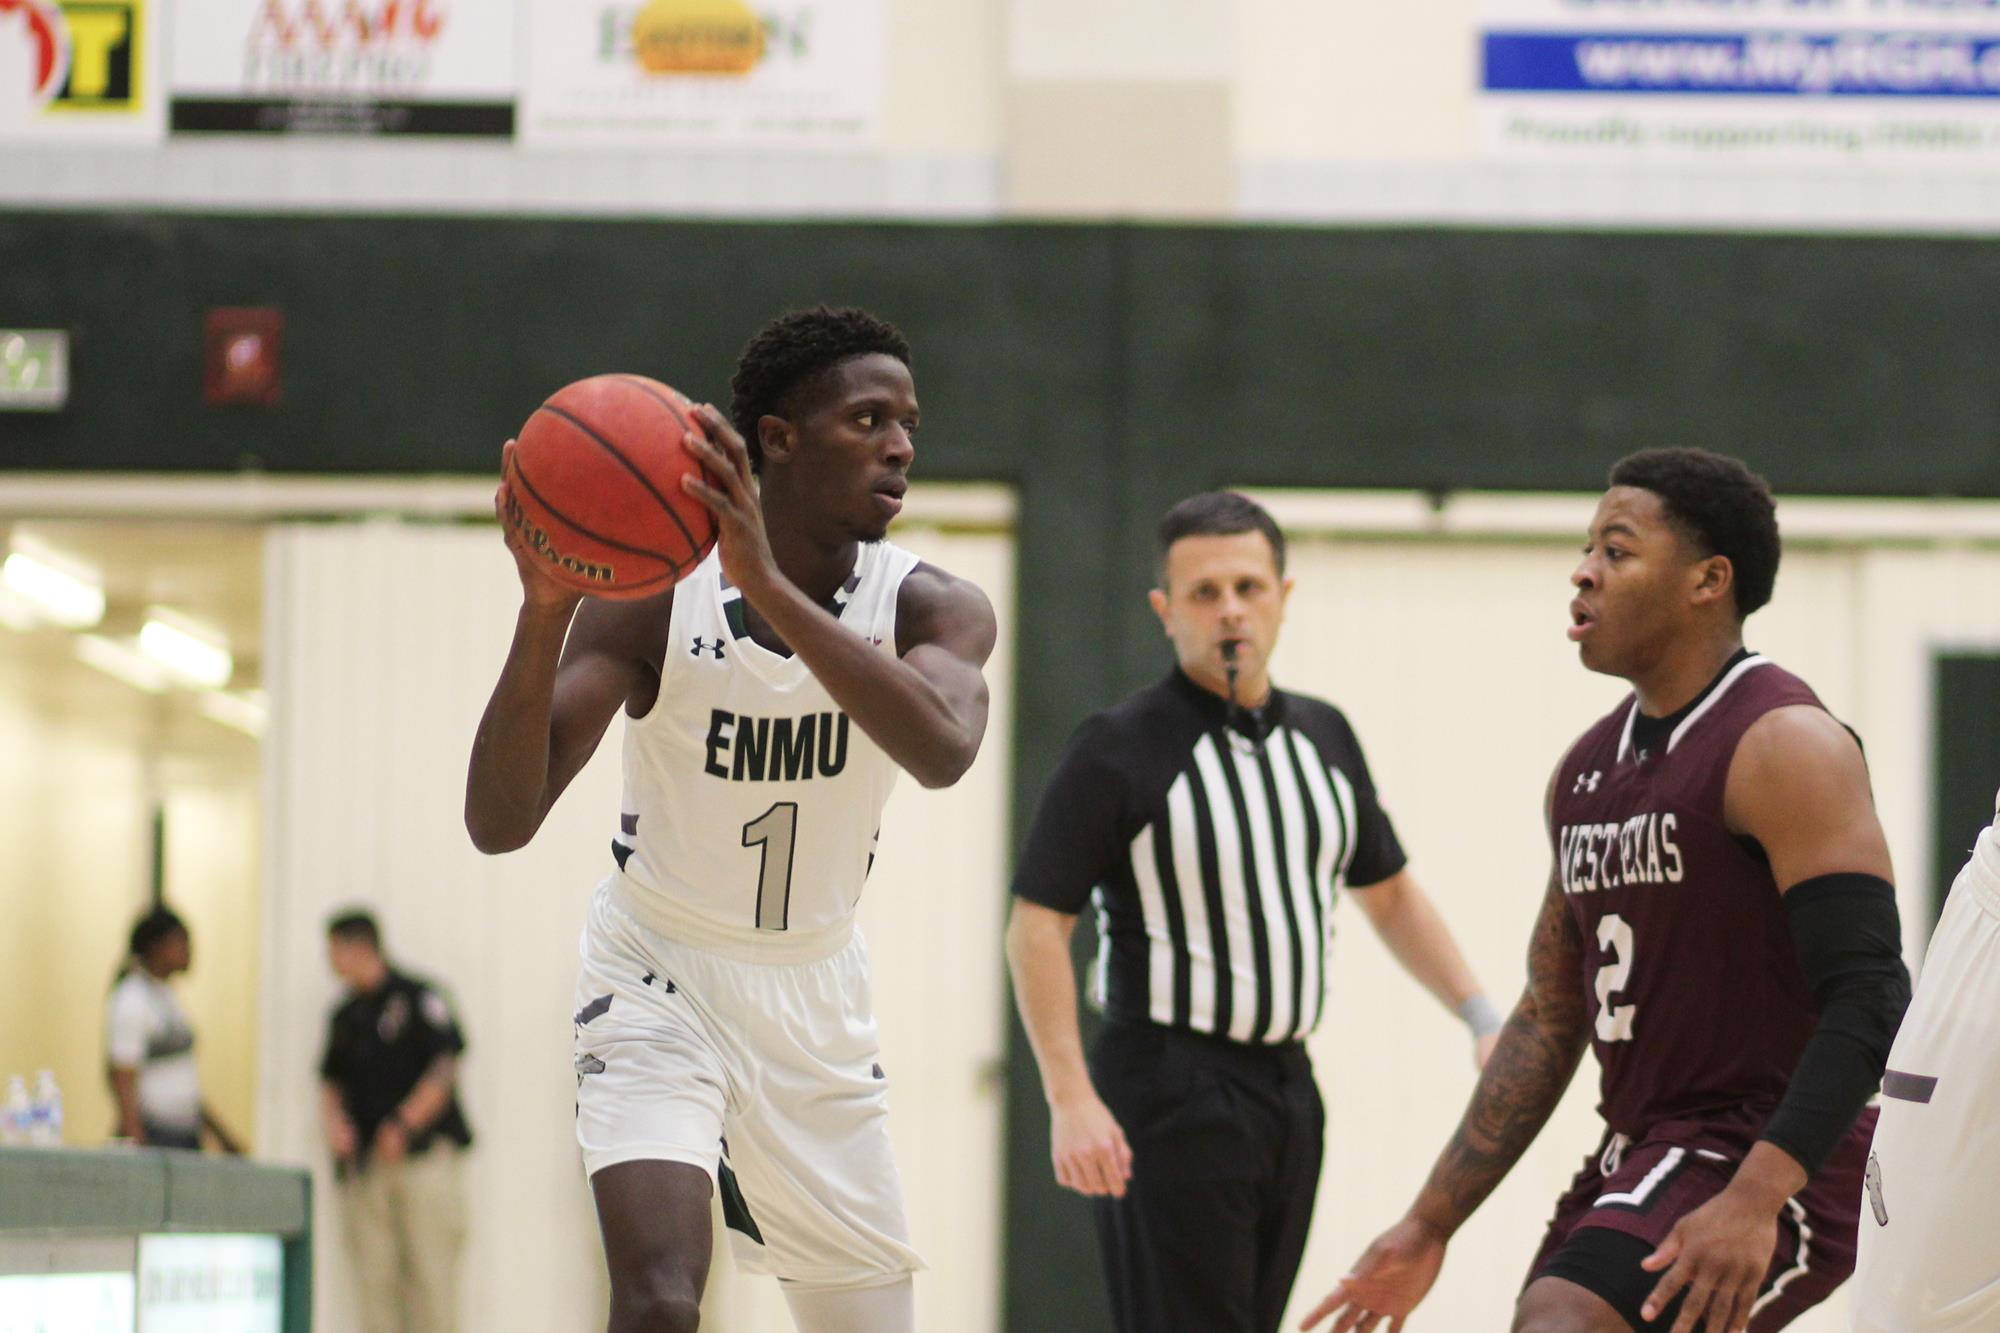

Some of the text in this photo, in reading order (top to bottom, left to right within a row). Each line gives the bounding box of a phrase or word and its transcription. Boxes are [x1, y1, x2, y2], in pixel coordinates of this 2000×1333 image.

[704, 708, 848, 782] ENMU
[741, 801, 798, 931] 1
[1594, 913, 1636, 1043] 2
